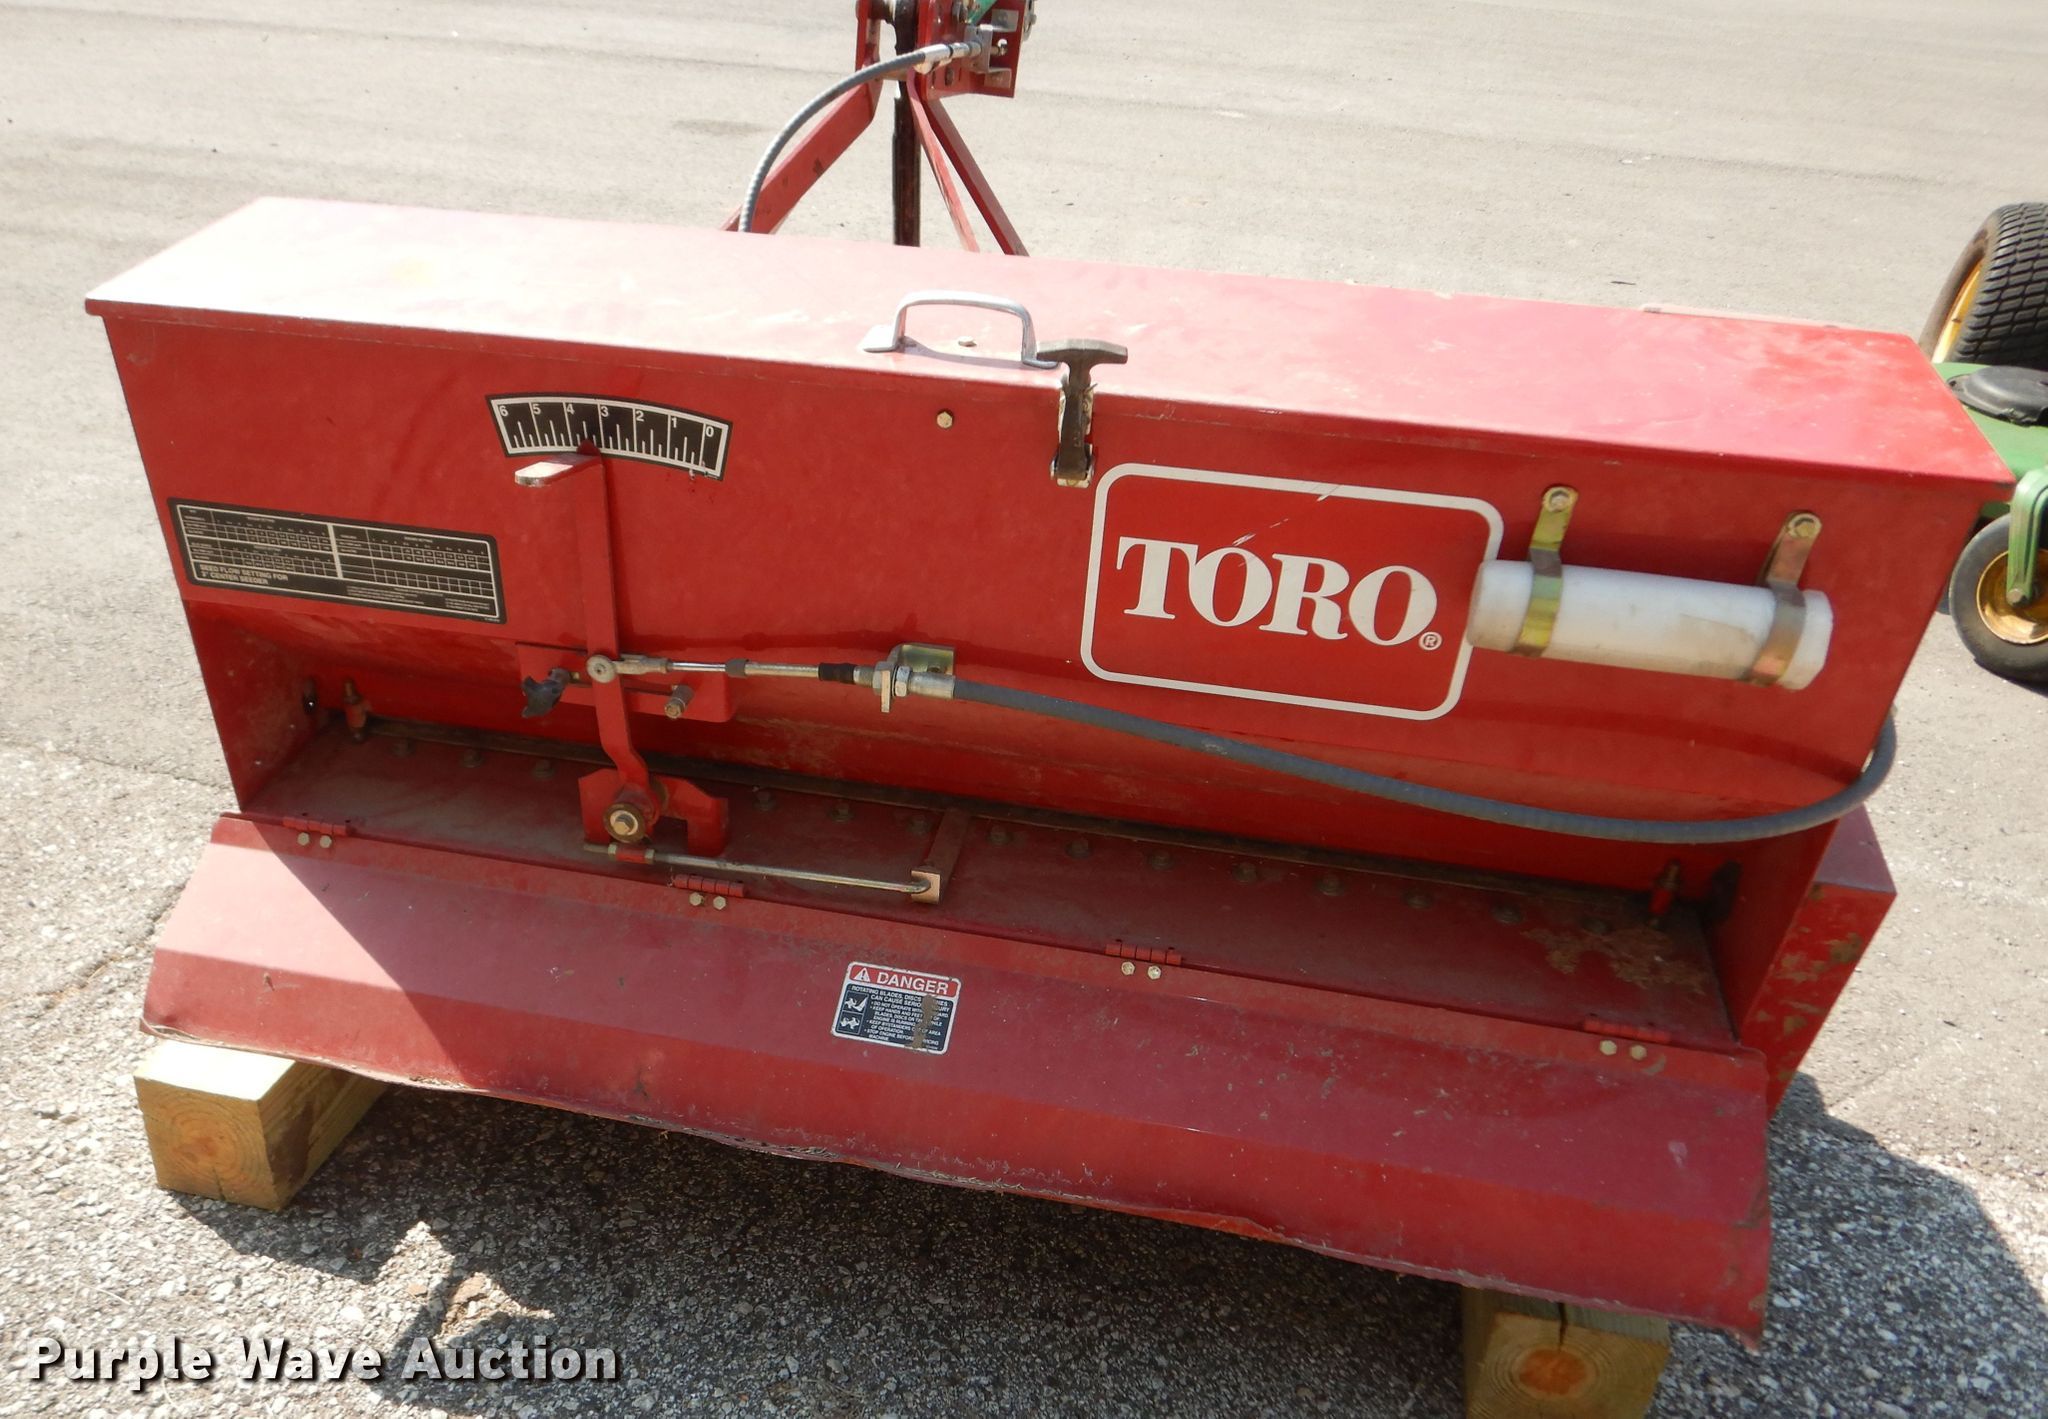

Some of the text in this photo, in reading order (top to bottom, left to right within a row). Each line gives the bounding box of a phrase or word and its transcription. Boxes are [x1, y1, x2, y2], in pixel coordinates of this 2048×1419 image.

[498, 403, 714, 437] 6 5 4 3 2 1 0
[220, 566, 240, 574] FLOW
[241, 569, 272, 579] SETTING
[1116, 536, 1437, 646] TORO
[852, 986, 879, 994] ROTATING
[876, 971, 949, 995] DANGER
